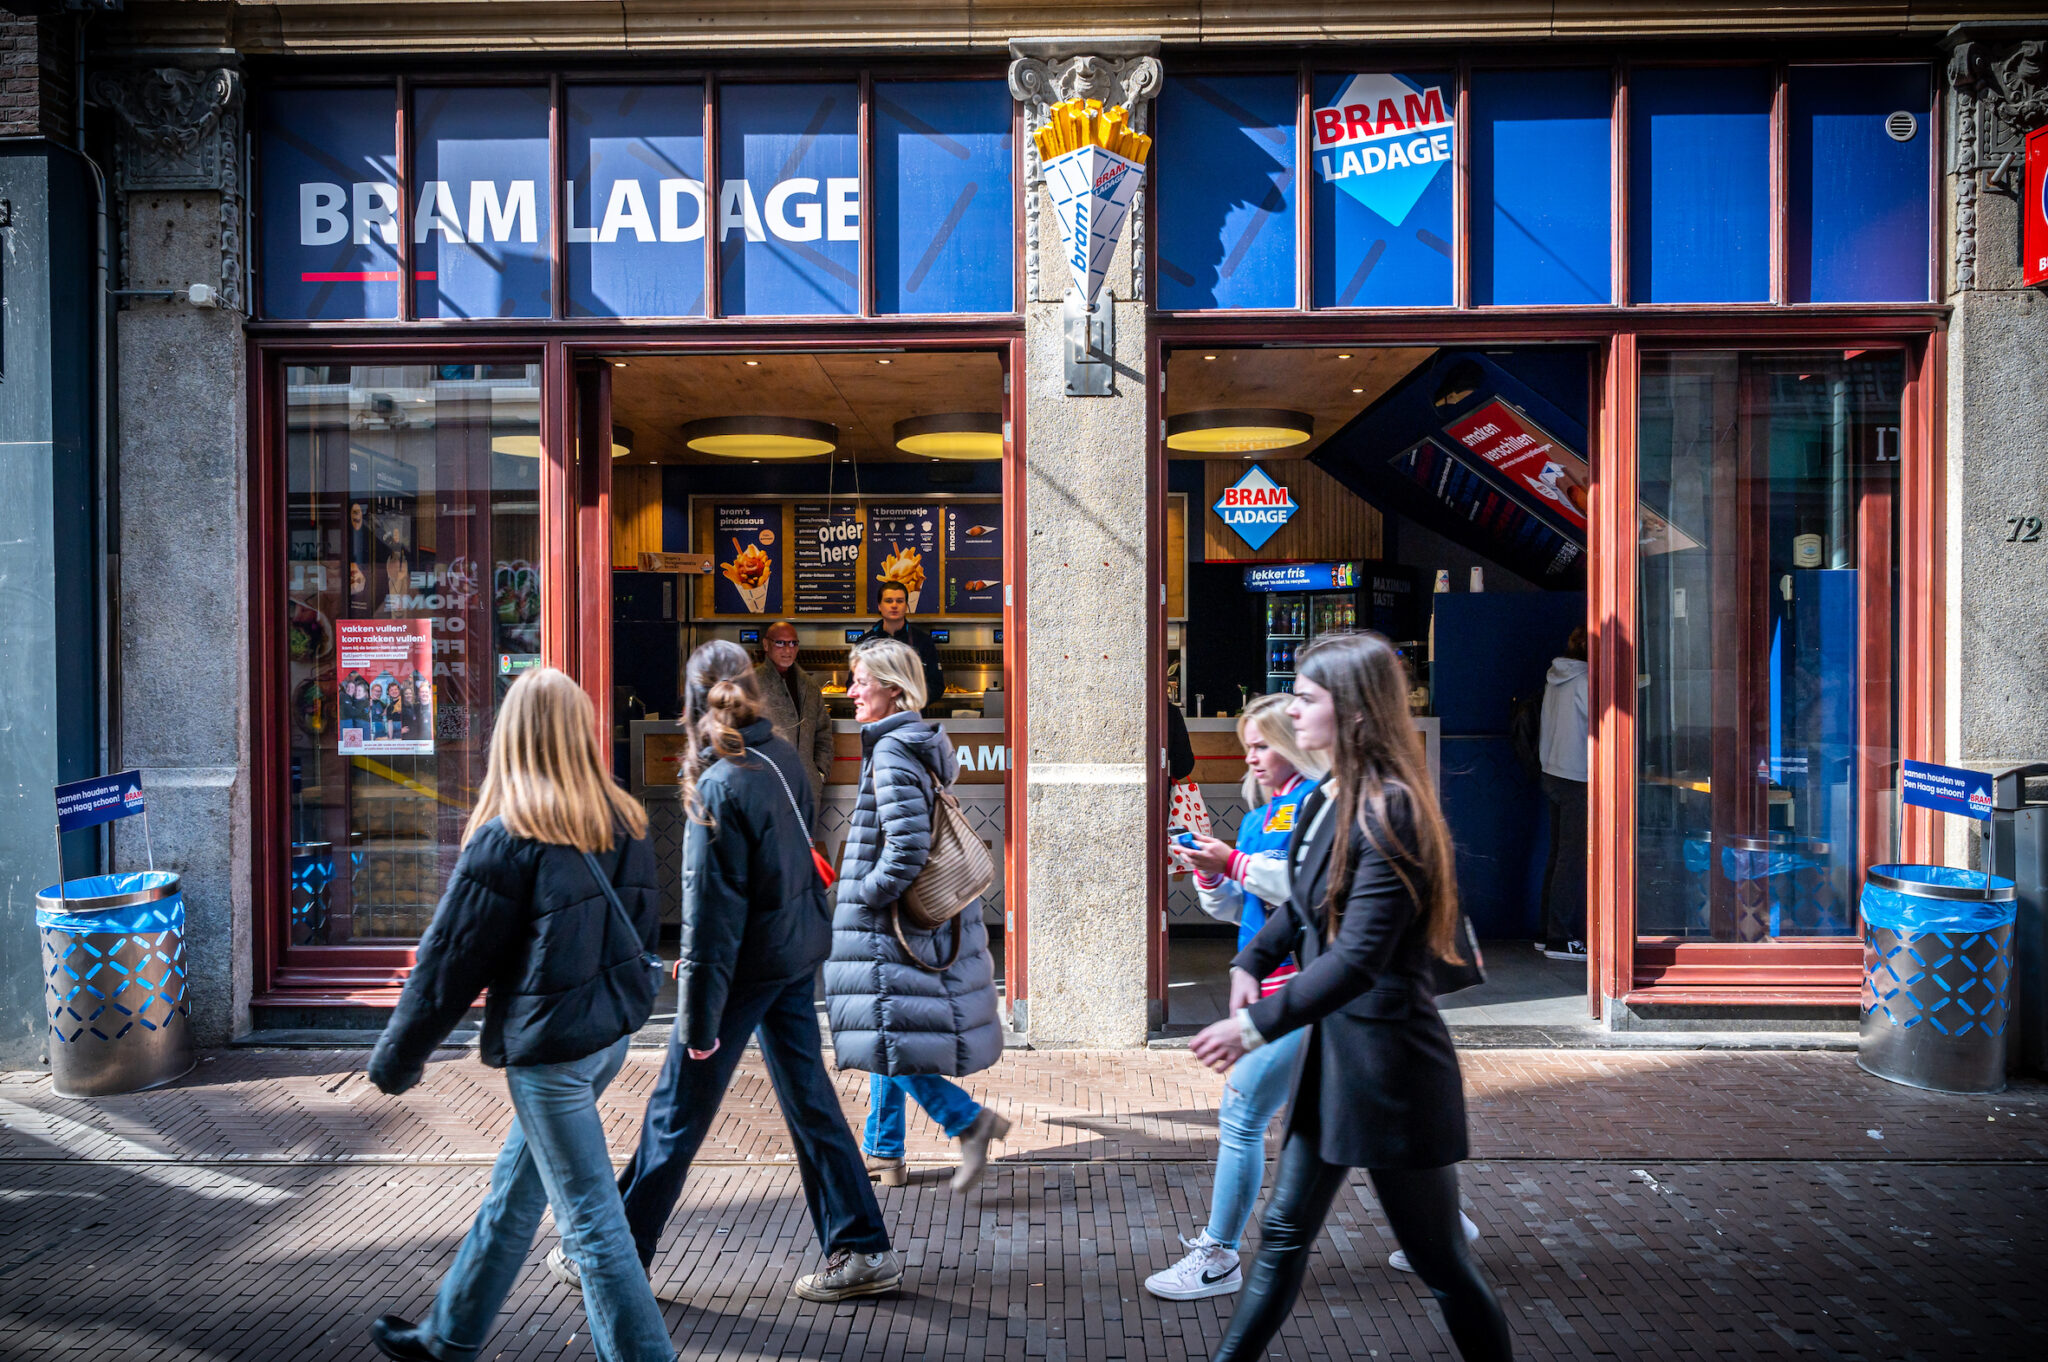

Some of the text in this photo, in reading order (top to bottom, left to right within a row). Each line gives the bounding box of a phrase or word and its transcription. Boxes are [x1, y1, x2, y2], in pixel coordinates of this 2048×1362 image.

[1315, 90, 1445, 144] BRAM
[1322, 134, 1450, 181] LADAGE
[1095, 162, 1125, 188] BRAM
[1095, 173, 1125, 196] LADAGE
[300, 178, 859, 246] BRAM LADAGE
[1071, 202, 1088, 273] bram
[1462, 422, 1501, 447] smaken
[1482, 432, 1536, 462] verschillen
[1225, 488, 1287, 505] BRAM
[720, 508, 750, 516] bram's
[881, 508, 928, 517] brammetje
[1225, 510, 1287, 523] LADAGE
[720, 517, 764, 526] pindasaus
[2006, 516, 2042, 542] 72
[818, 521, 863, 542] order
[820, 543, 858, 563] here
[1252, 567, 1305, 581] lekker fris
[1373, 576, 1411, 593] MAXIMUM
[1373, 592, 1395, 607] TASTE
[341, 624, 407, 633] vakken vullen?
[341, 634, 426, 643] kom zakken vullen!
[1904, 770, 1965, 787] samen houden we
[57, 792, 81, 804] samen
[82, 787, 108, 799] houden
[125, 791, 142, 801] BRAM
[1904, 780, 1964, 798] Den Haag schoon!
[58, 794, 120, 816] Den Haag schoon!
[1970, 794, 1991, 805] BRAM
[1970, 803, 1990, 813] LADAGE
